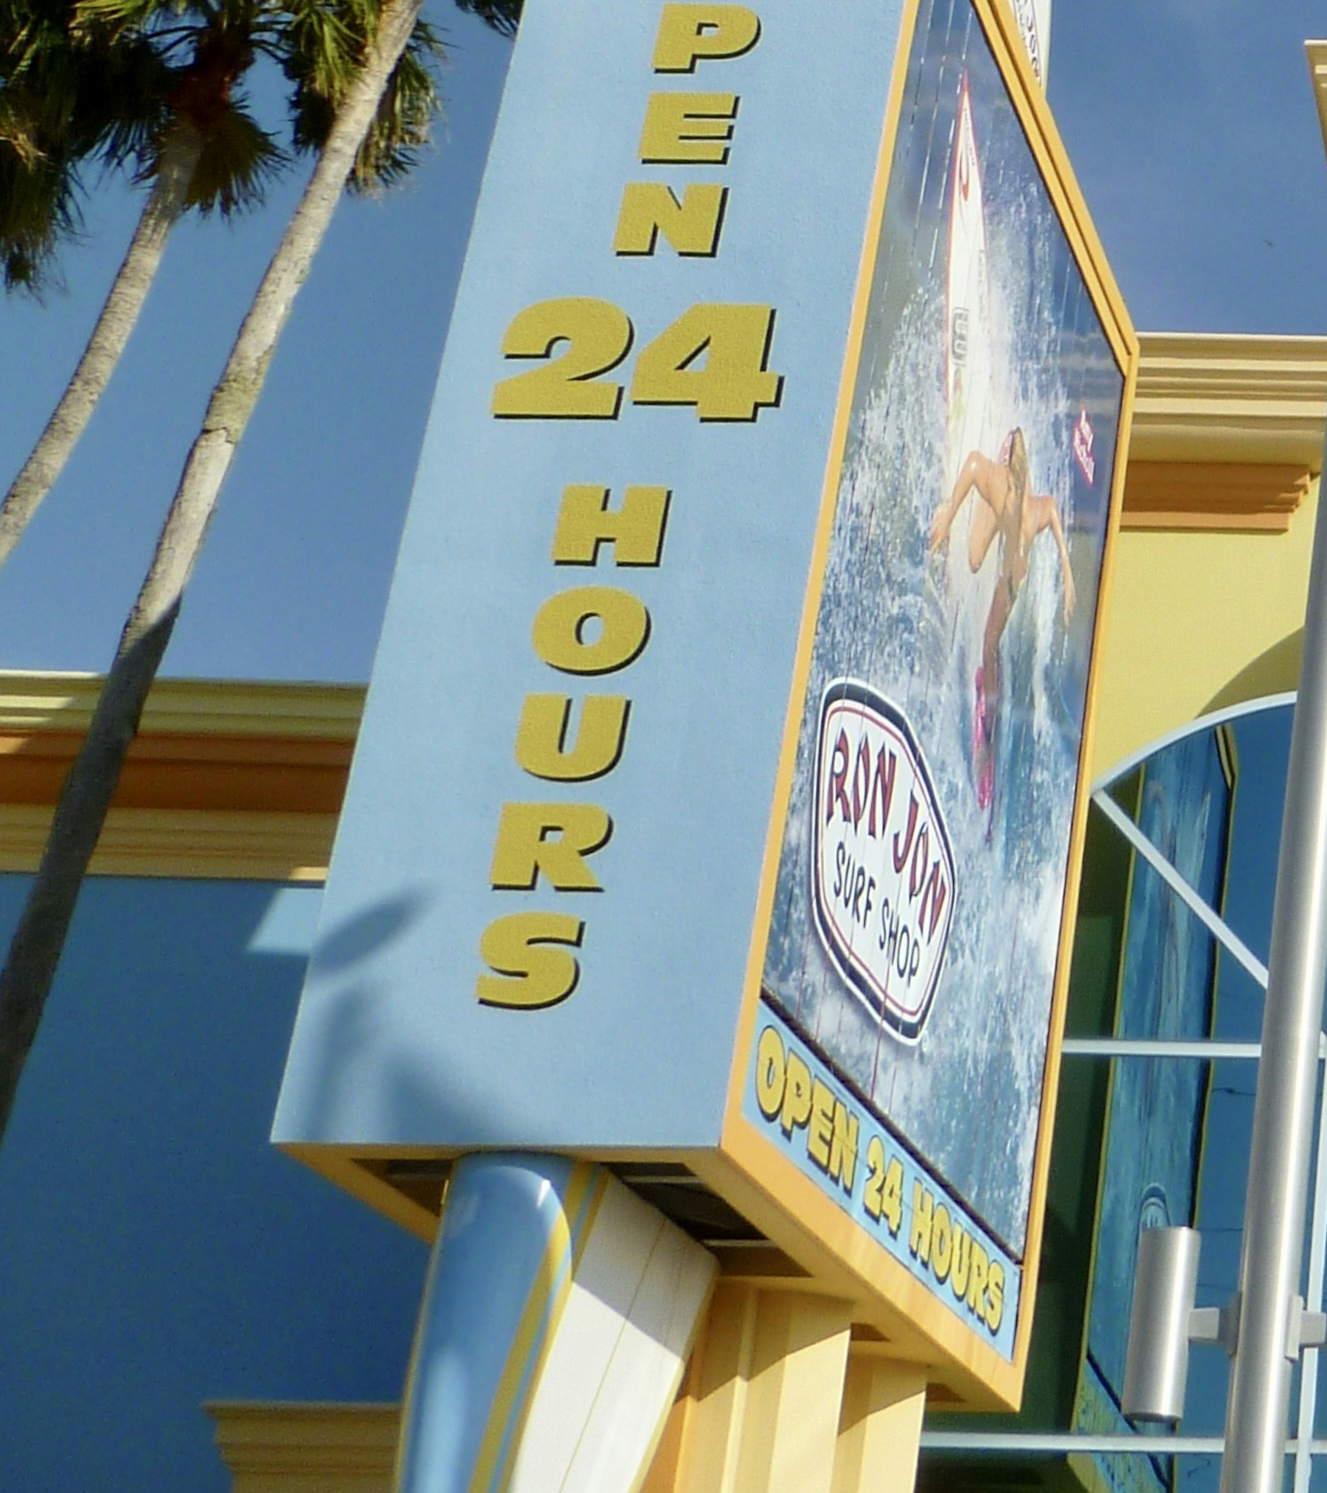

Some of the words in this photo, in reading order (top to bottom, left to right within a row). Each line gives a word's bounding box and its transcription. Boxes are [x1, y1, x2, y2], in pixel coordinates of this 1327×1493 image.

[490, 297, 786, 422] 24
[475, 484, 672, 1011] HOURS
[826, 726, 897, 840] RON
[893, 789, 947, 946] JON
[833, 841, 877, 928] SURF
[879, 897, 921, 988] SHOP
[756, 1025, 860, 1198] OPEN
[863, 1131, 905, 1239] 24
[908, 1177, 1007, 1336] HOURS
